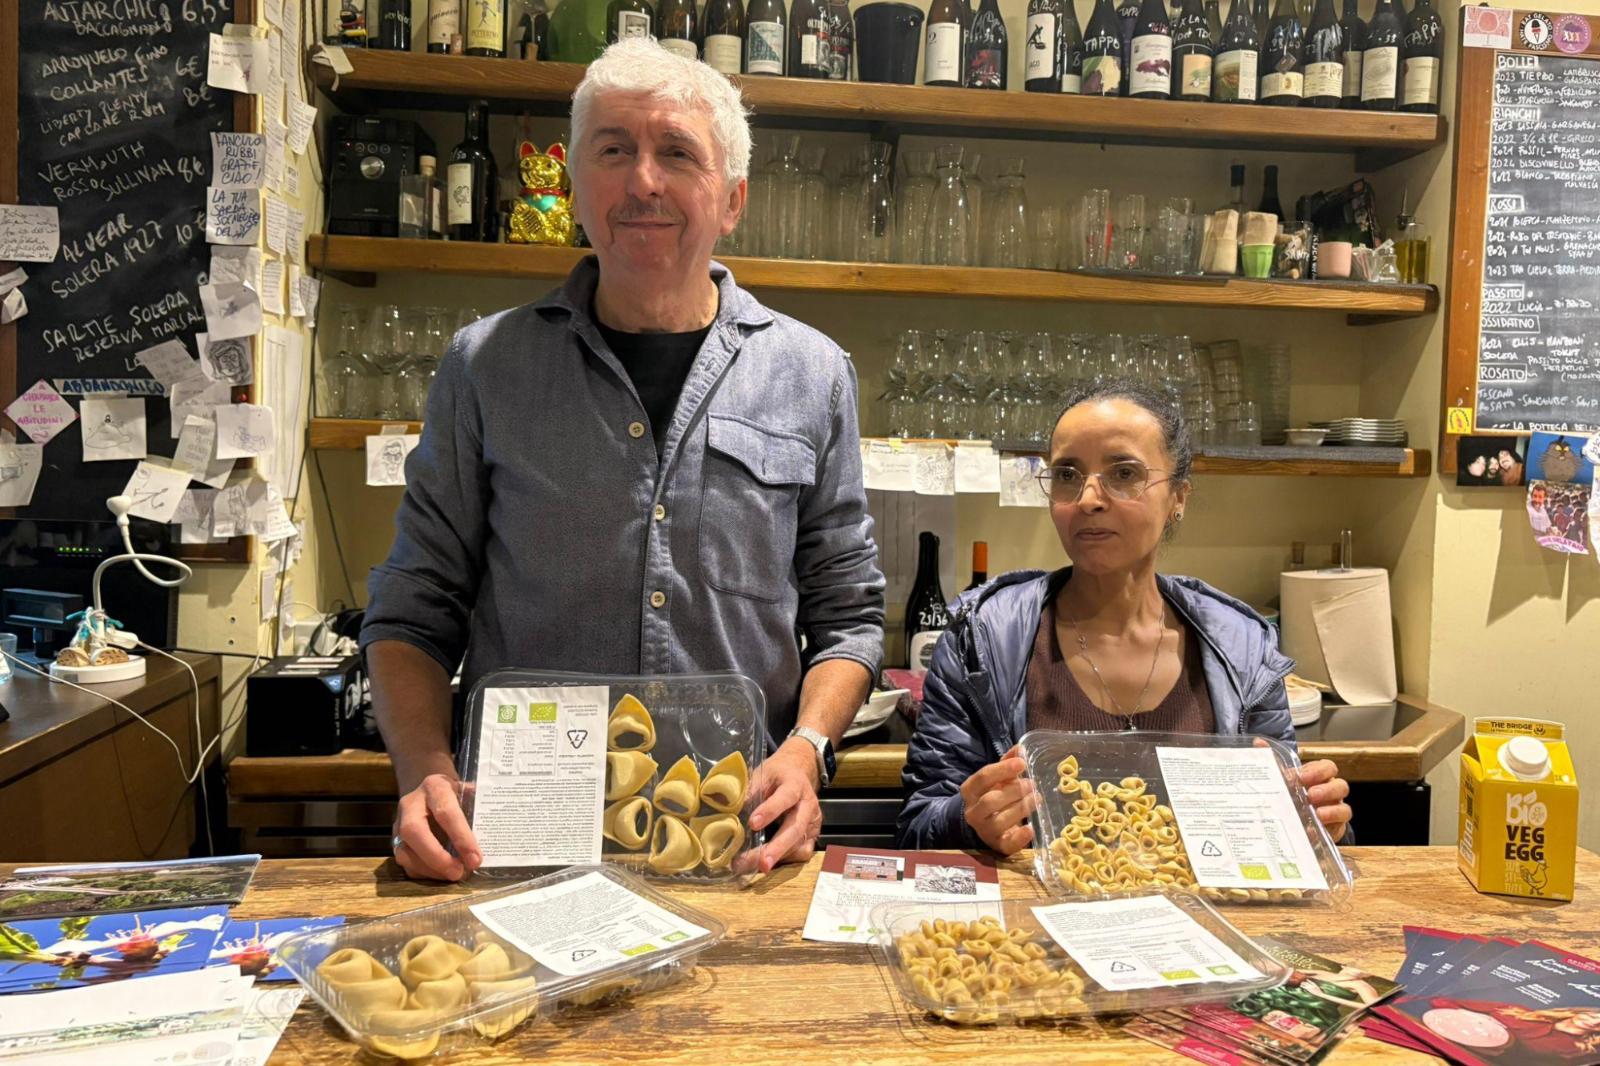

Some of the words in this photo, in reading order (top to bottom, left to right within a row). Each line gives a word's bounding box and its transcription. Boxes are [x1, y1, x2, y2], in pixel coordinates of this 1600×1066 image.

[1083, 35, 1121, 53] TAPPO
[50, 65, 149, 101] COLLANTES
[53, 177, 98, 202] ROSSO
[51, 253, 120, 299] SOLERA
[123, 220, 164, 264] 1927
[129, 289, 190, 327] SOLERA
[1491, 721, 1505, 729] THE
[1506, 722, 1533, 731] BRIDGE
[1506, 824, 1545, 845] VEG
[1505, 843, 1545, 862] EGG
